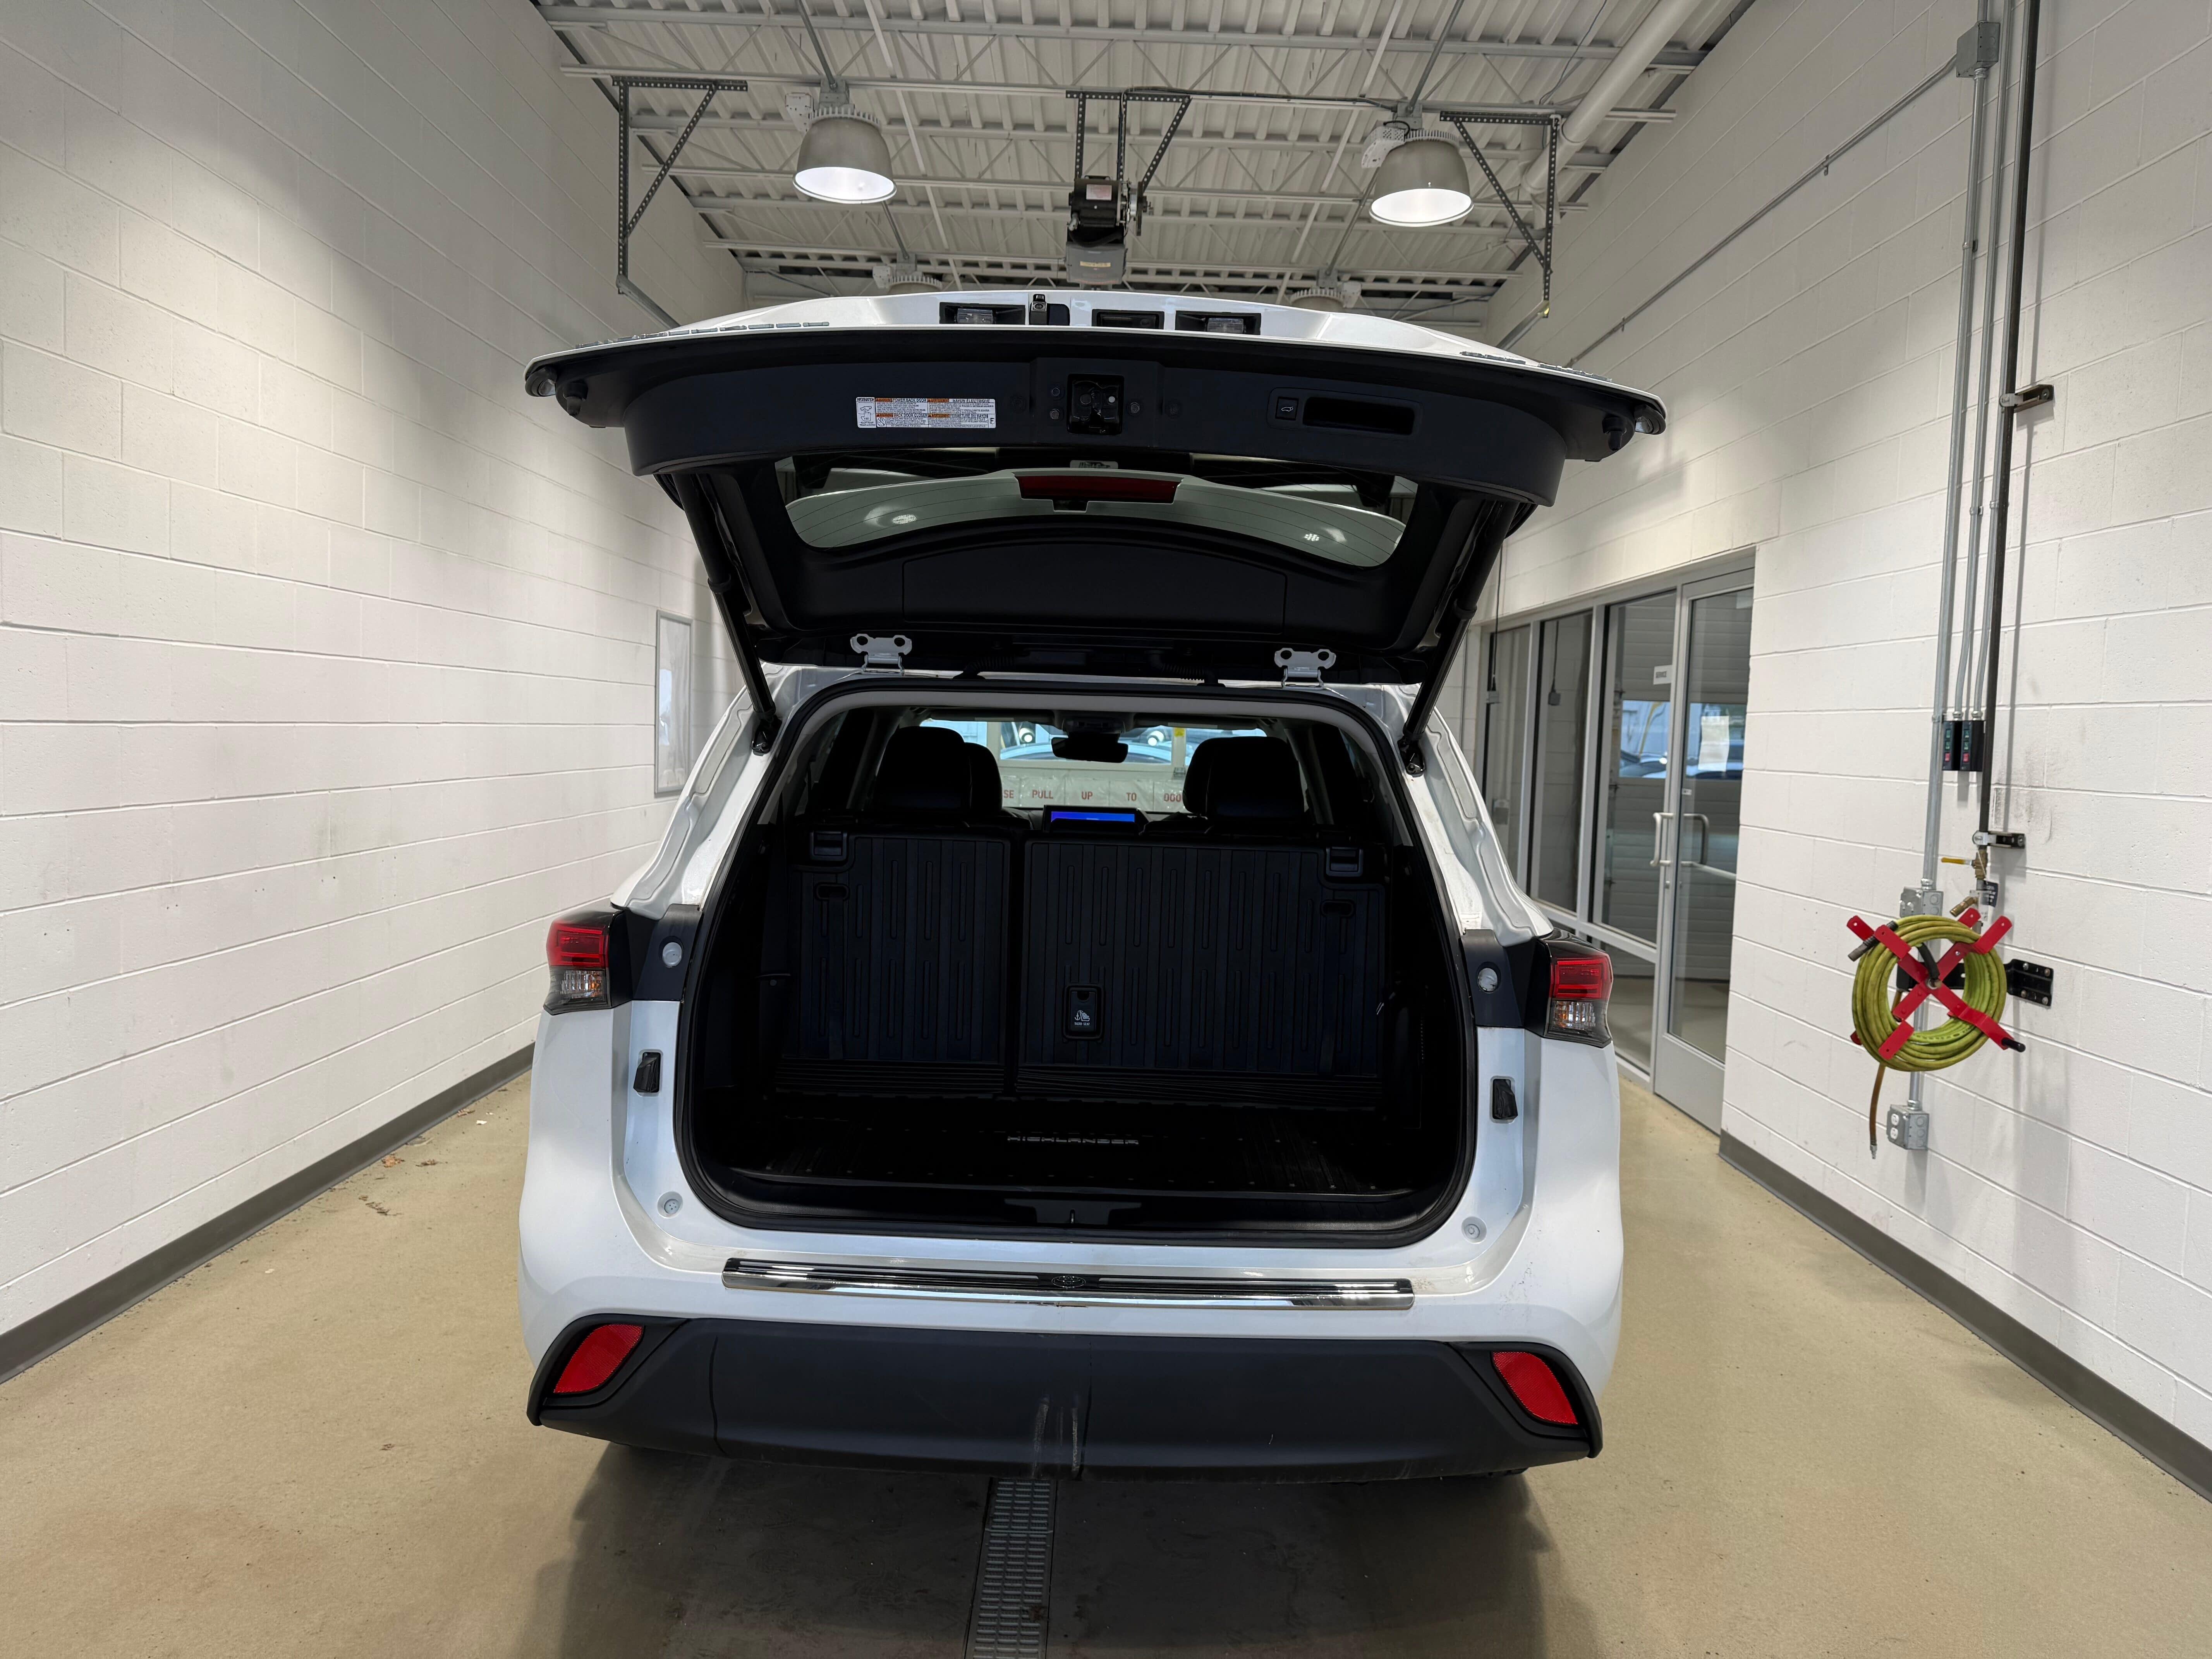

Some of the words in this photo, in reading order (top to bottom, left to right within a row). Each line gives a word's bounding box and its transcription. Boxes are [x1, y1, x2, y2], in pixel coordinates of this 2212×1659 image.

[1032, 790, 1054, 799] PULL
[1081, 791, 1093, 800] UP
[1126, 792, 1137, 801] TO
